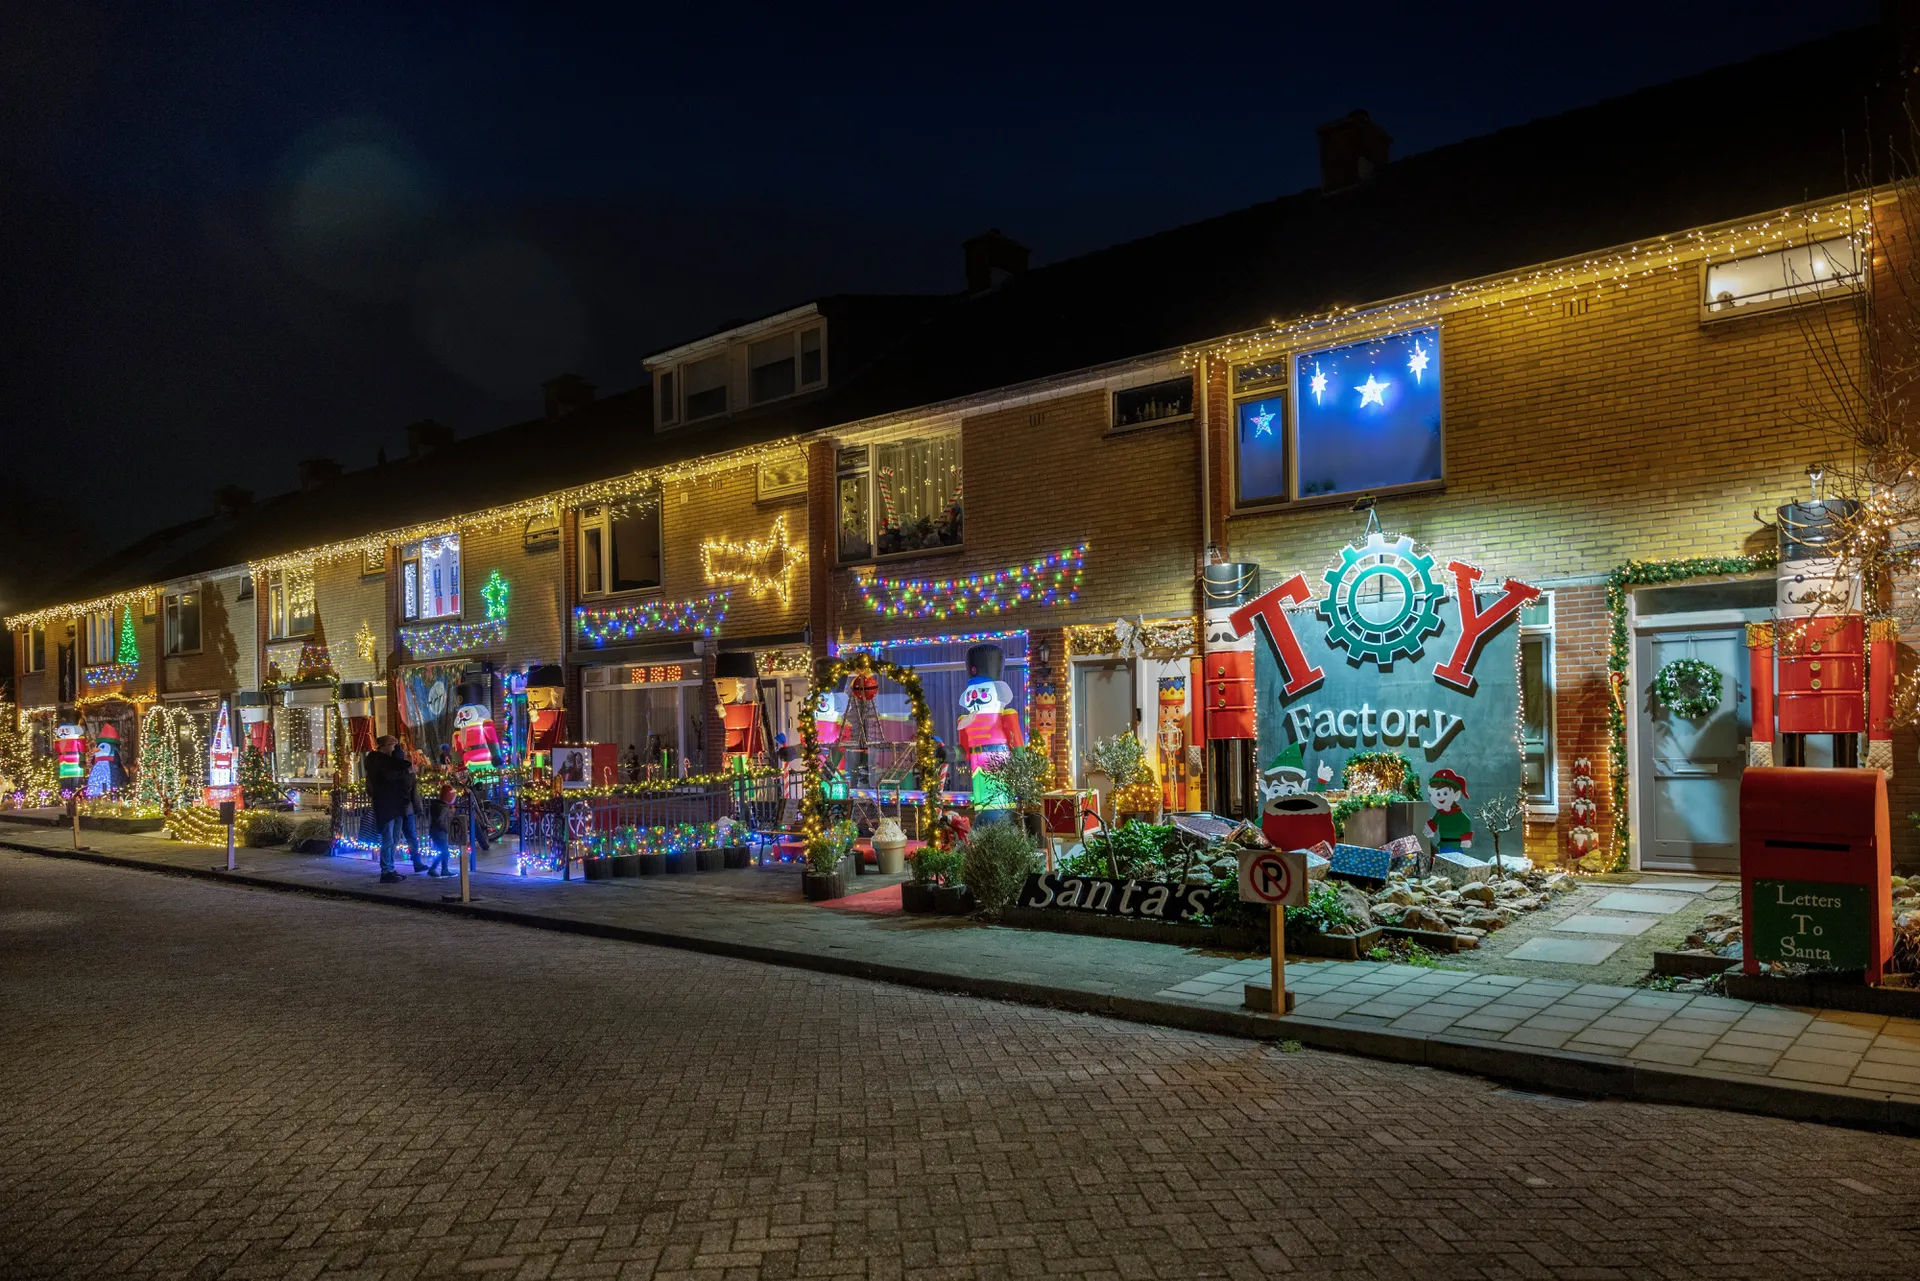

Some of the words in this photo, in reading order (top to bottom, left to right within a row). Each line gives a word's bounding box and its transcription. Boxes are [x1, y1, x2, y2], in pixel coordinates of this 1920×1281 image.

[1228, 533, 1543, 697] TOY
[1287, 703, 1462, 749] Factory
[1262, 862, 1283, 893] P
[1029, 871, 1210, 919] Santa's
[1776, 884, 1841, 908] Letters
[1791, 914, 1823, 936] To
[1780, 936, 1831, 960] Santa
